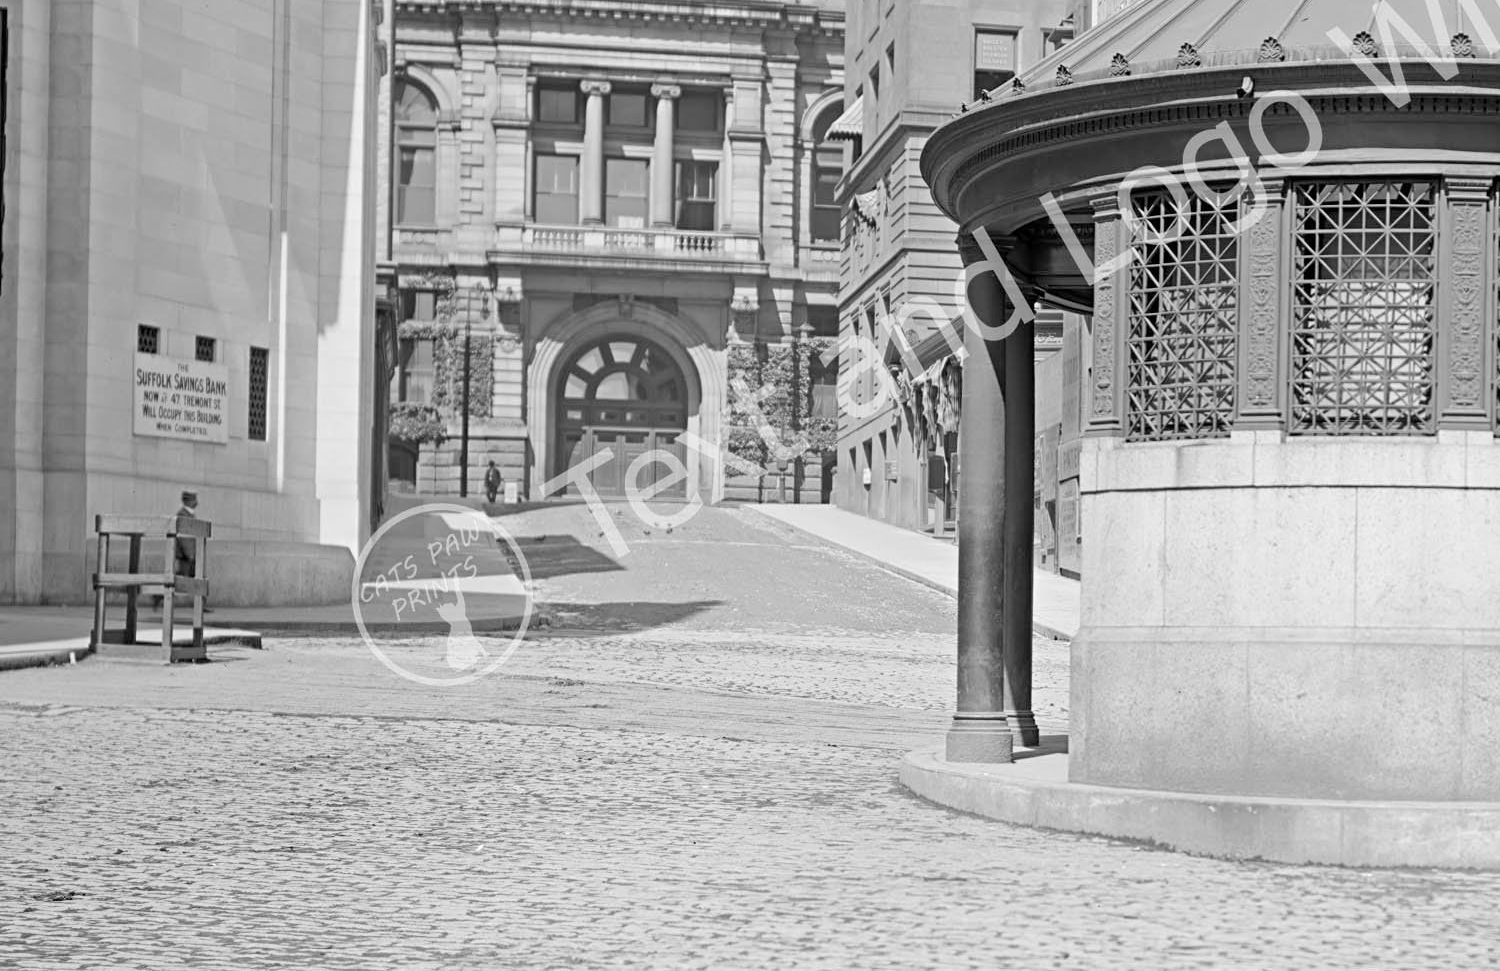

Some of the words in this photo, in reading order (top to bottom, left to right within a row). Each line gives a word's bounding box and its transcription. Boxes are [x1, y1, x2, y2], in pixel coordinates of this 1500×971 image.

[177, 363, 189, 372] THE
[136, 368, 172, 389] SUFFOLK
[174, 373, 204, 393] SAVINGS
[205, 376, 227, 396] BANK
[143, 390, 159, 402] NOW
[170, 393, 180, 404] 47
[183, 394, 212, 409] TREMONT
[142, 404, 157, 418] WILL
[158, 405, 182, 421] OCCUPY
[183, 410, 196, 422] THIS
[196, 410, 222, 425] BUILDING
